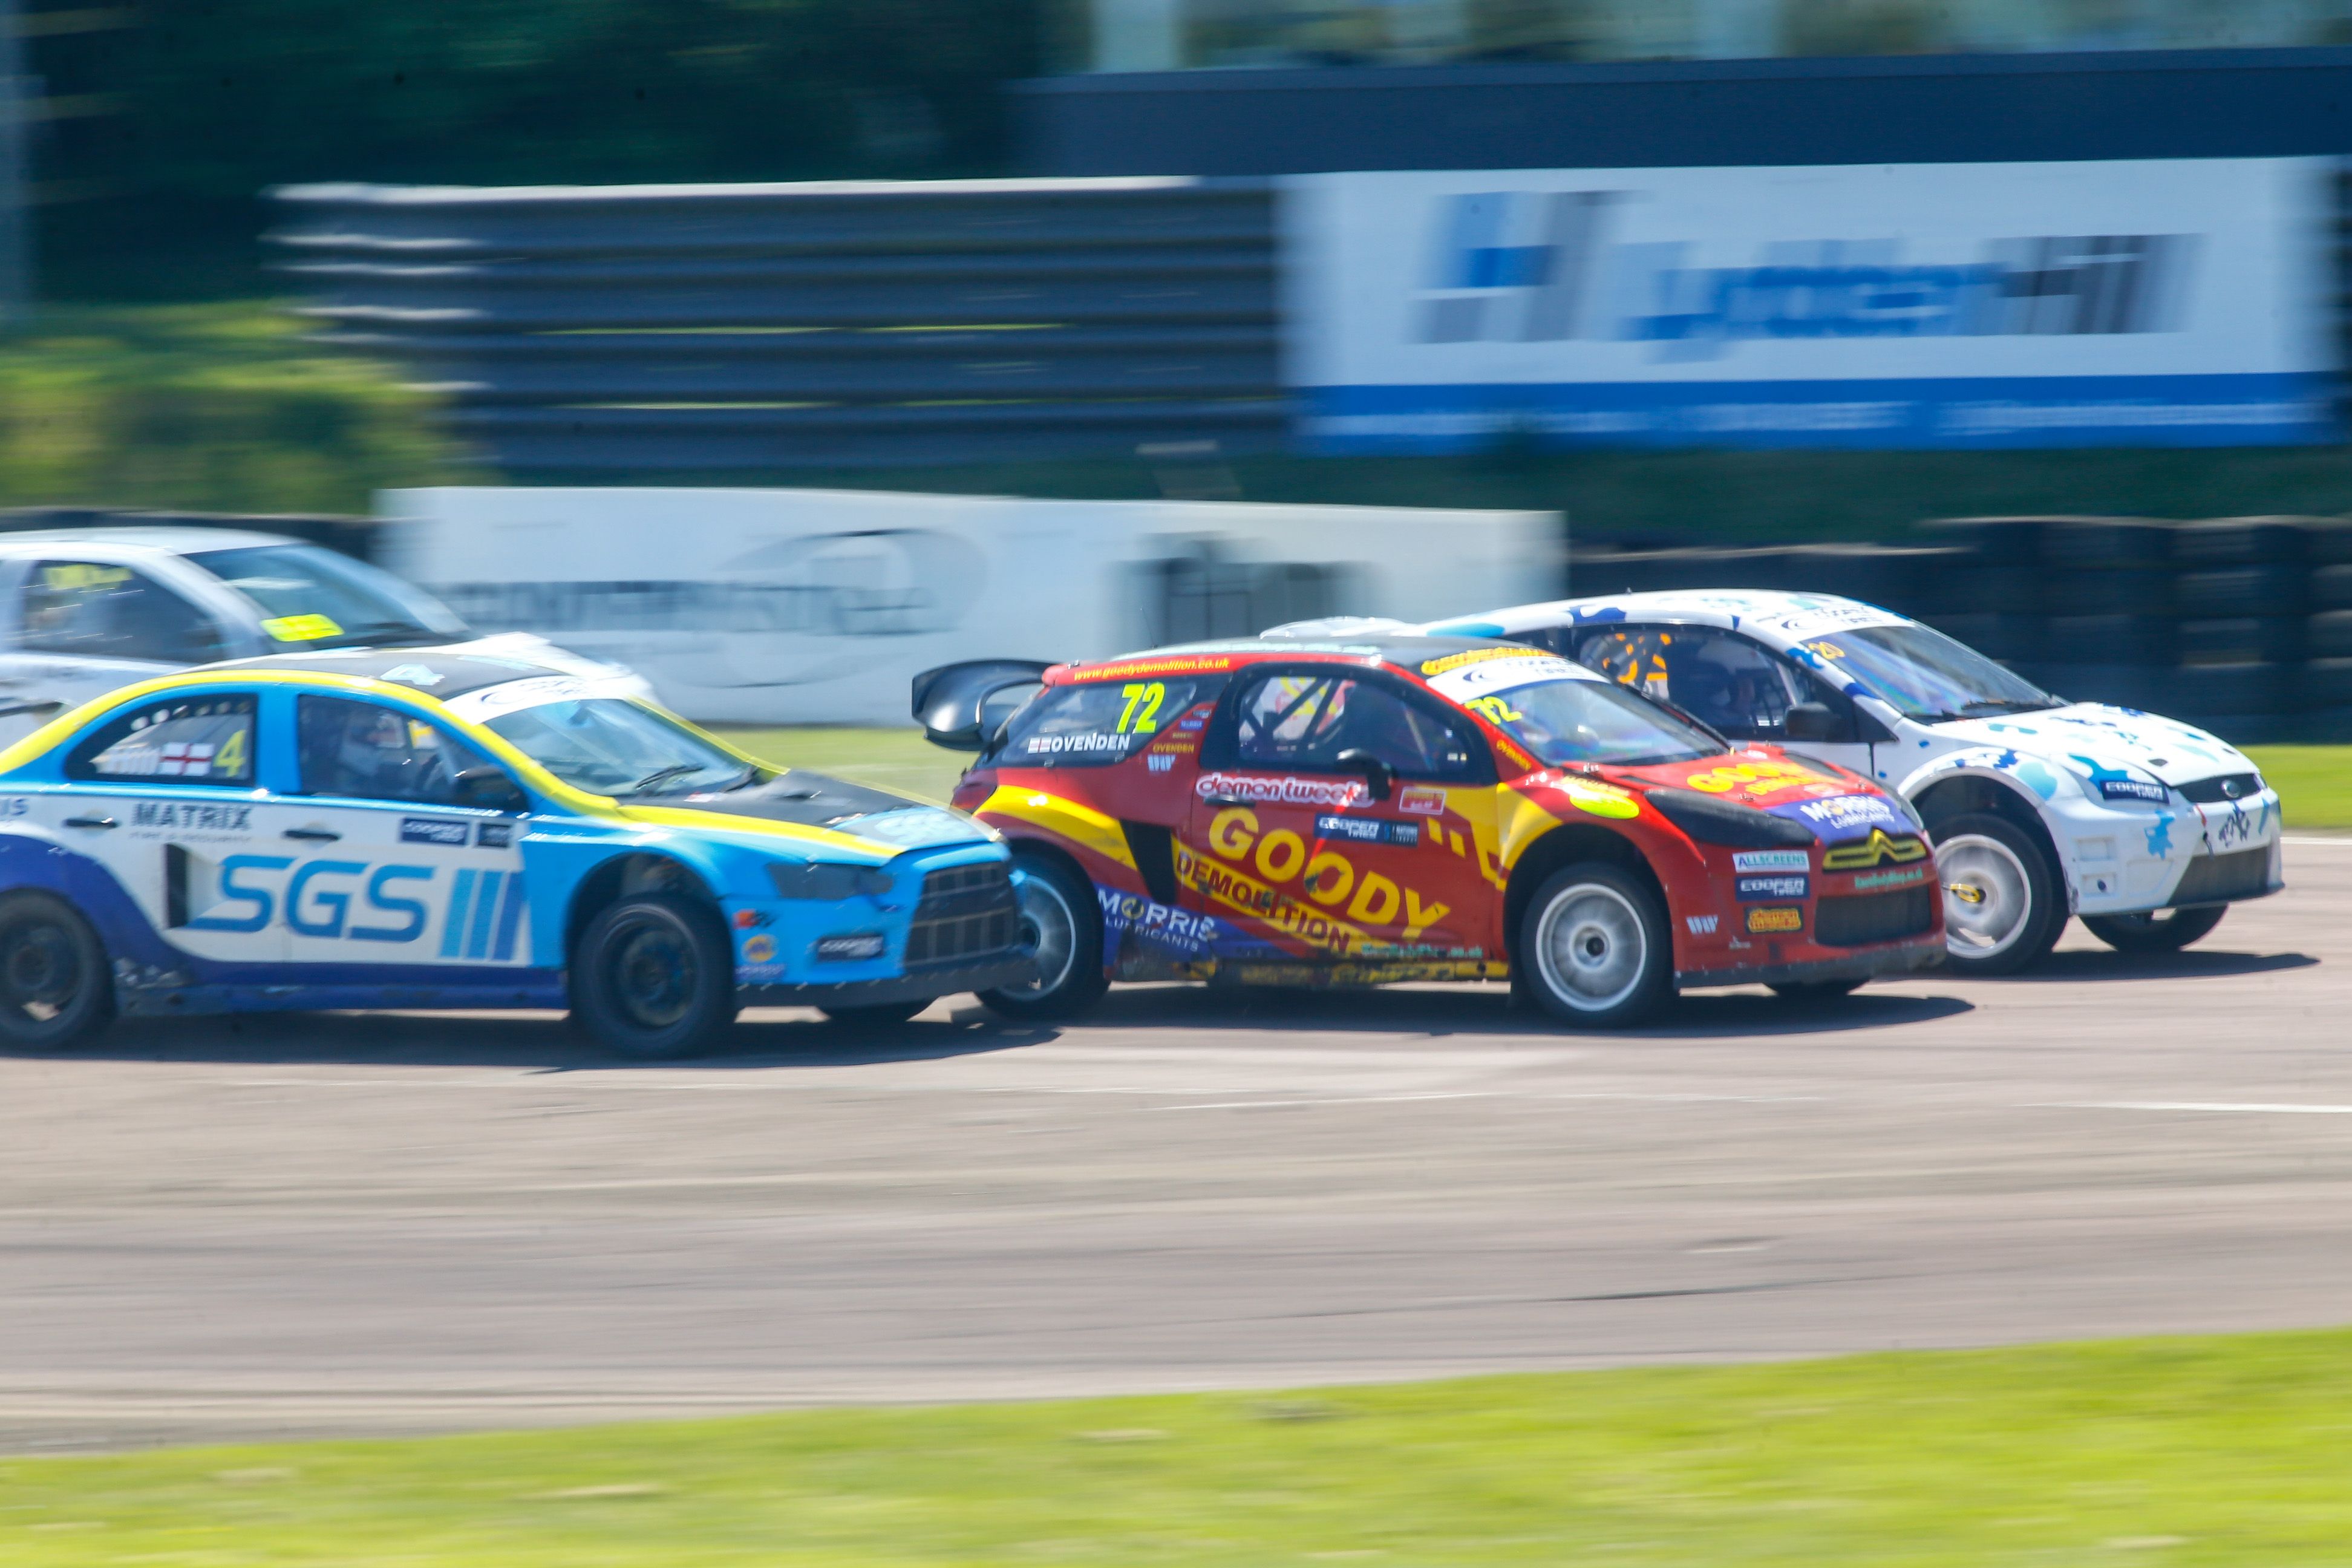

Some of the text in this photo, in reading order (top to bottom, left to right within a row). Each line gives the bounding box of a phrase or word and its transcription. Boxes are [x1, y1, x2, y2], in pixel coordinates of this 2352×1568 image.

[1116, 682, 1166, 734] 72
[1463, 696, 1522, 725] 72
[212, 729, 247, 779] 4
[1050, 733, 1131, 752] OVENDEN
[132, 802, 254, 831] MATRIX
[1319, 817, 1380, 833] COOPER
[187, 854, 437, 943] SGS
[1209, 806, 1451, 942] GOODY
[1740, 877, 1805, 892] COOPER
[1097, 888, 1215, 942] MORRIS
[1176, 850, 1351, 953] DEMOLITION
